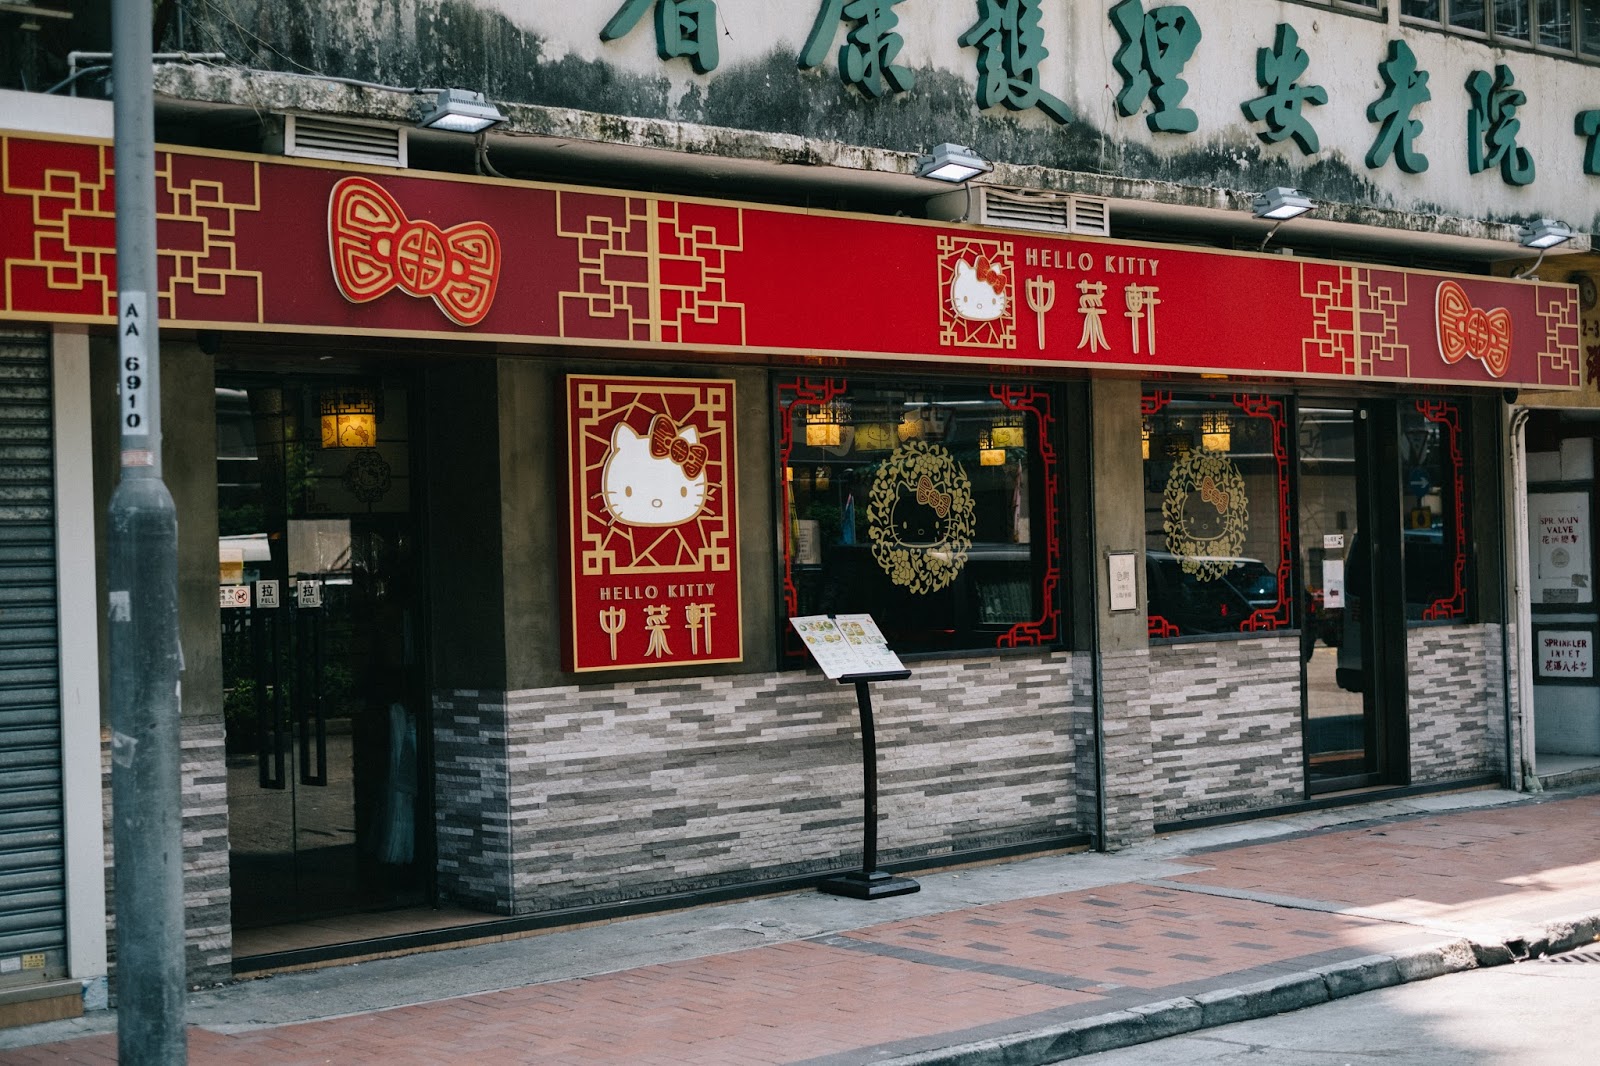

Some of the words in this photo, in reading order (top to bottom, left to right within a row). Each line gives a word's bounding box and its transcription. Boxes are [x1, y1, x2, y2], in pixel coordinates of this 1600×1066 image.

[1025, 247, 1094, 271] HELLO
[1105, 255, 1160, 276] KITTY
[125, 303, 139, 336] AA
[1025, 274, 1161, 356] 中菜軒
[125, 357, 141, 428] 6910
[1558, 516, 1579, 524] MAIN
[1546, 526, 1574, 534] VALVE
[261, 584, 273, 597] 拉
[303, 584, 314, 597] 拉
[600, 585, 658, 600] HELLO
[668, 583, 716, 598] KITTY
[599, 602, 717, 661] 中菜軒
[1544, 638, 1587, 648] SPRINKLER
[1551, 649, 1581, 658] INLET
